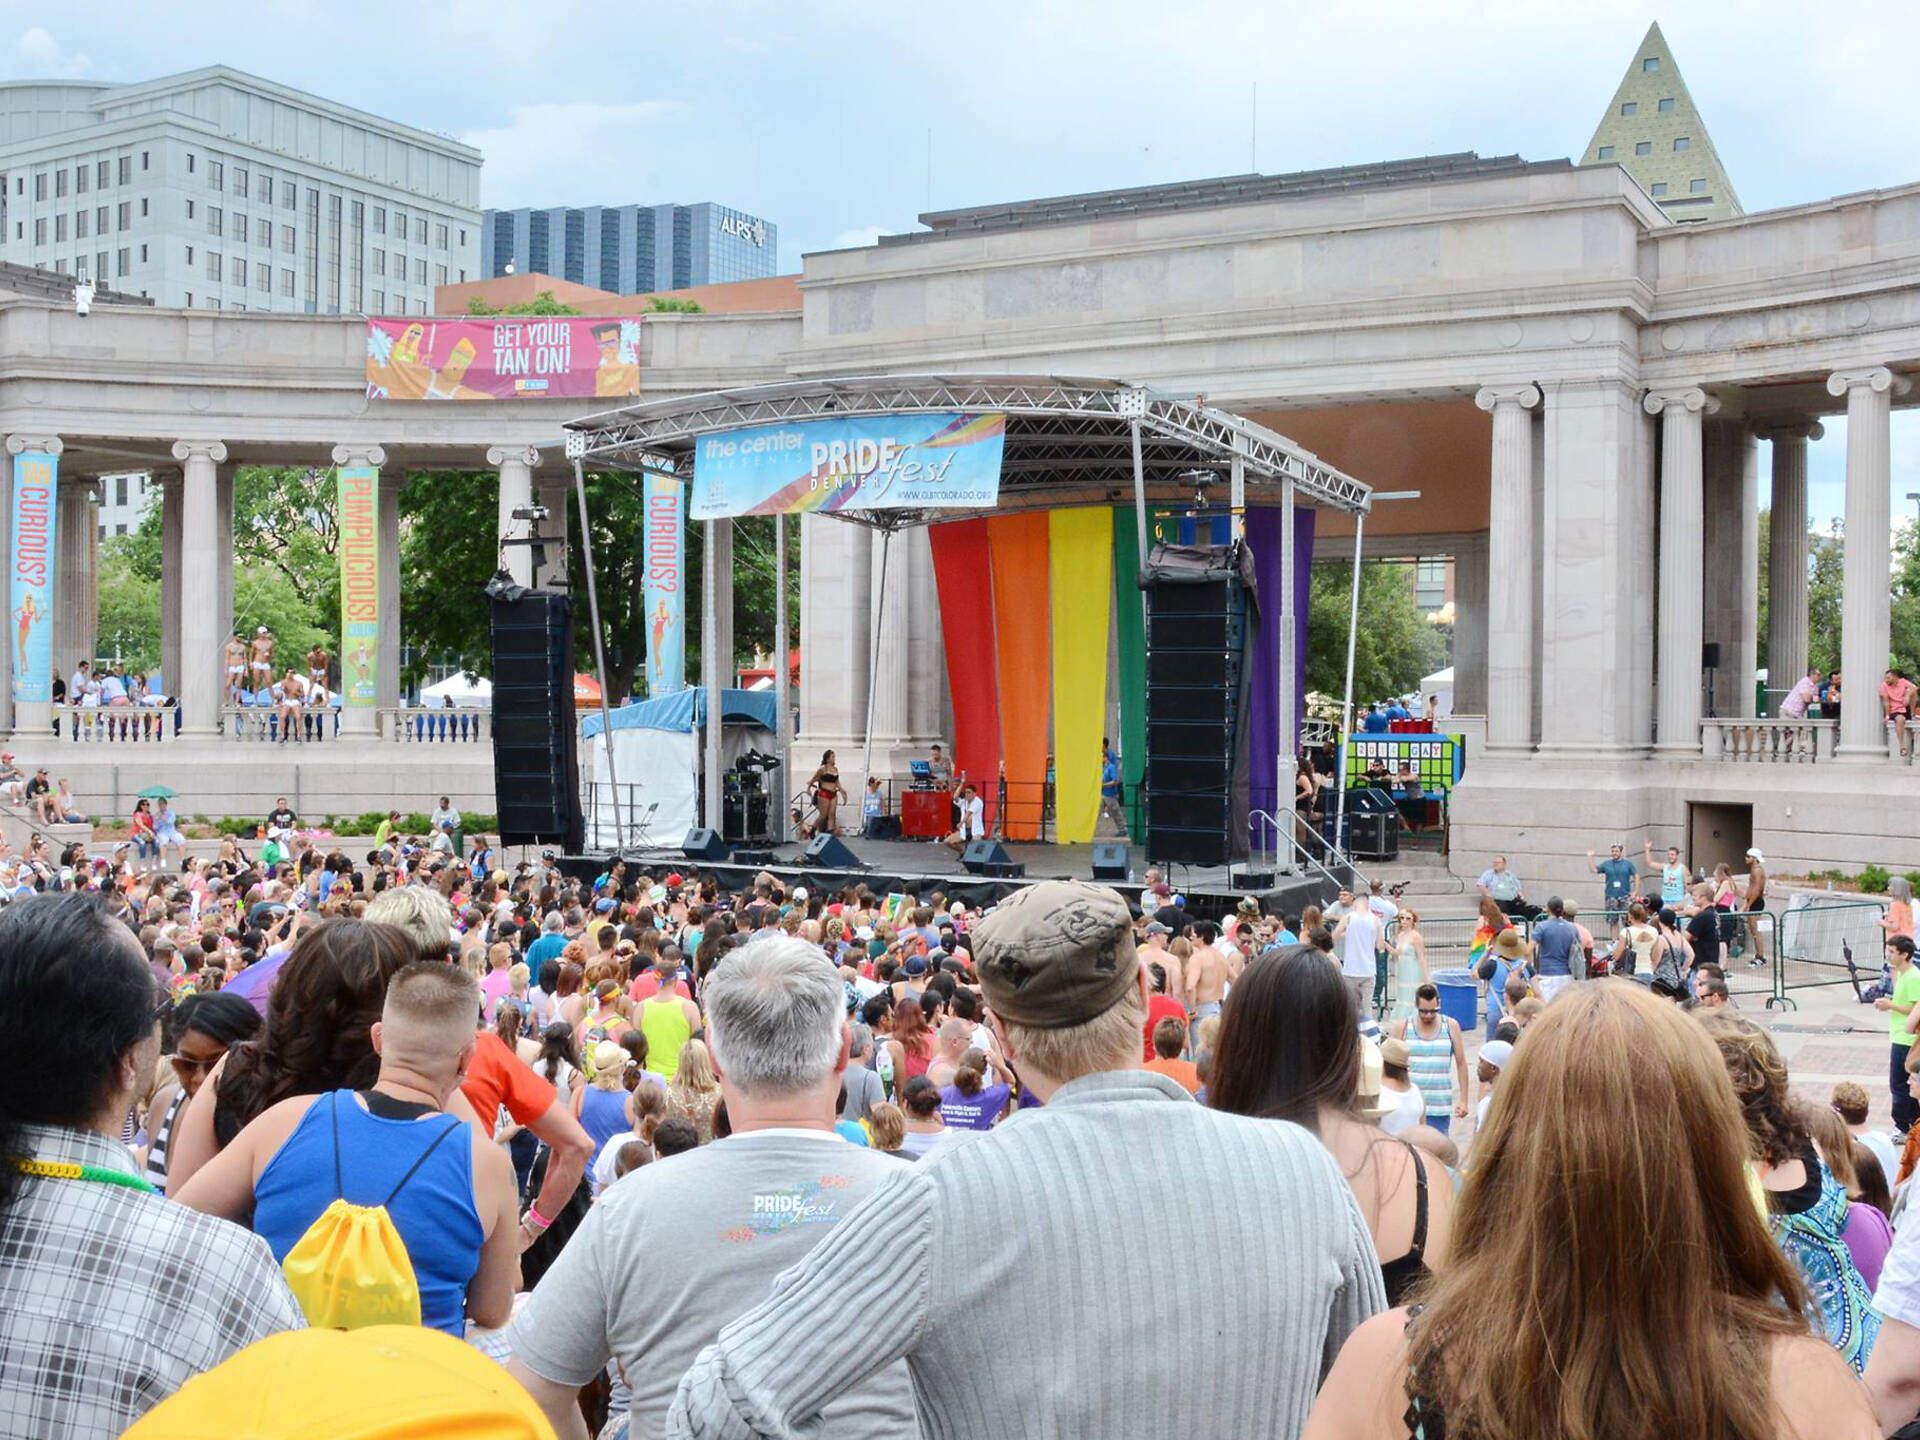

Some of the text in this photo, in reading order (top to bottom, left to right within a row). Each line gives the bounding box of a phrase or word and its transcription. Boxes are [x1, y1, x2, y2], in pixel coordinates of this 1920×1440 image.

[721, 215, 752, 241] ALPS
[494, 322, 571, 347] GET YOUR
[492, 346, 571, 375] TAN ON!
[705, 430, 805, 459] the center
[811, 475, 879, 491] DENVER
[16, 486, 49, 587] CURIOUS?
[343, 477, 377, 622] PUMPILICIOUS!
[649, 495, 678, 592] CURIOUS?
[1411, 745, 1440, 757] GAY
